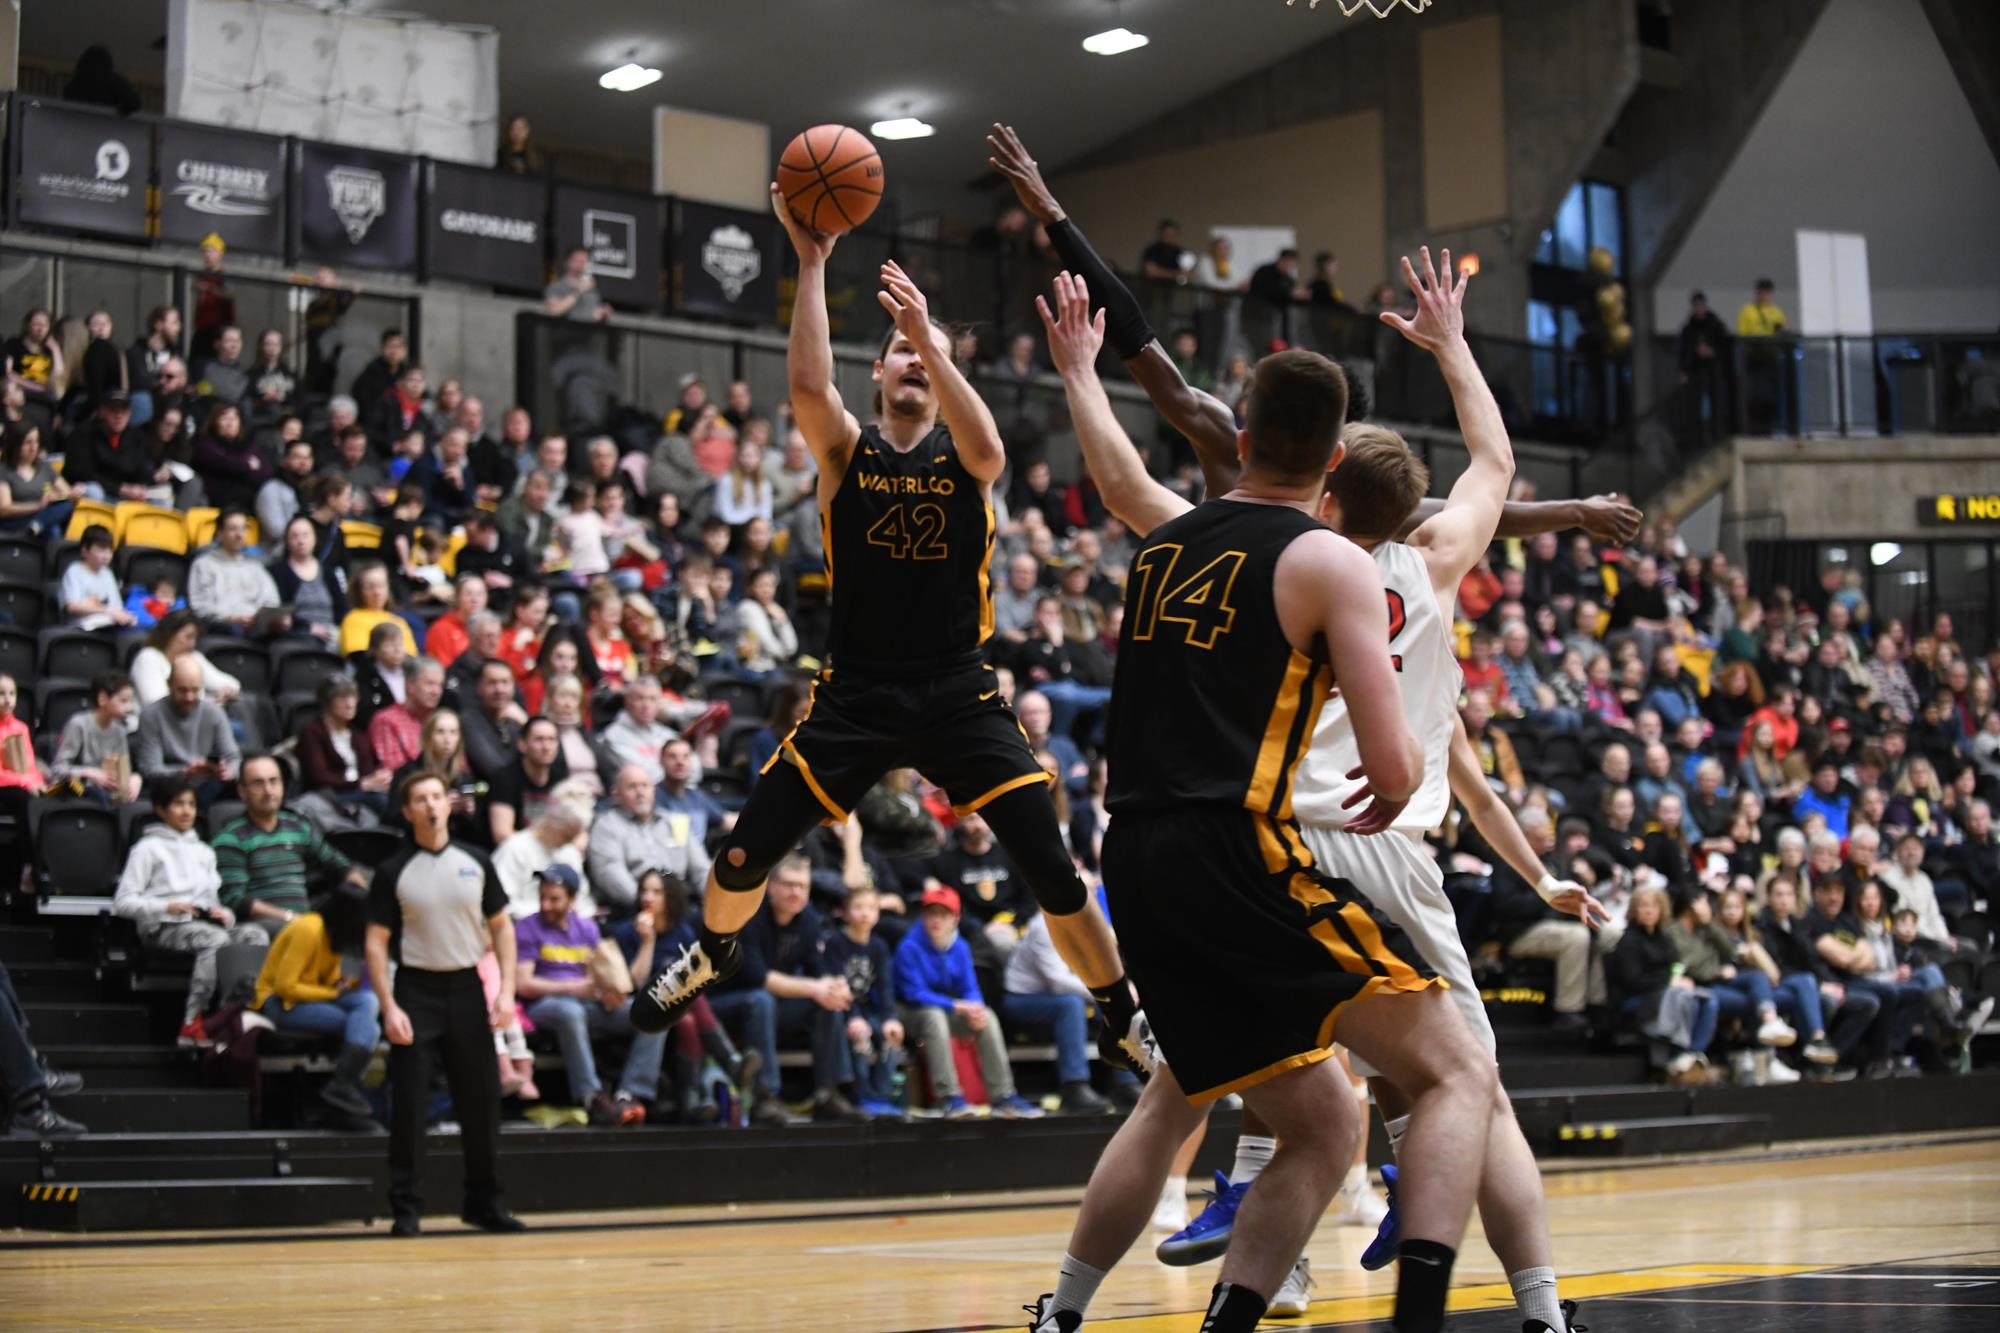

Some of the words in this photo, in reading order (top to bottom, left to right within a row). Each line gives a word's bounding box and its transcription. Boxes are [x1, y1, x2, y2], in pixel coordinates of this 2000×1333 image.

[441, 209, 537, 243] GATORADE
[866, 502, 948, 560] 42
[1133, 543, 1248, 650] 14
